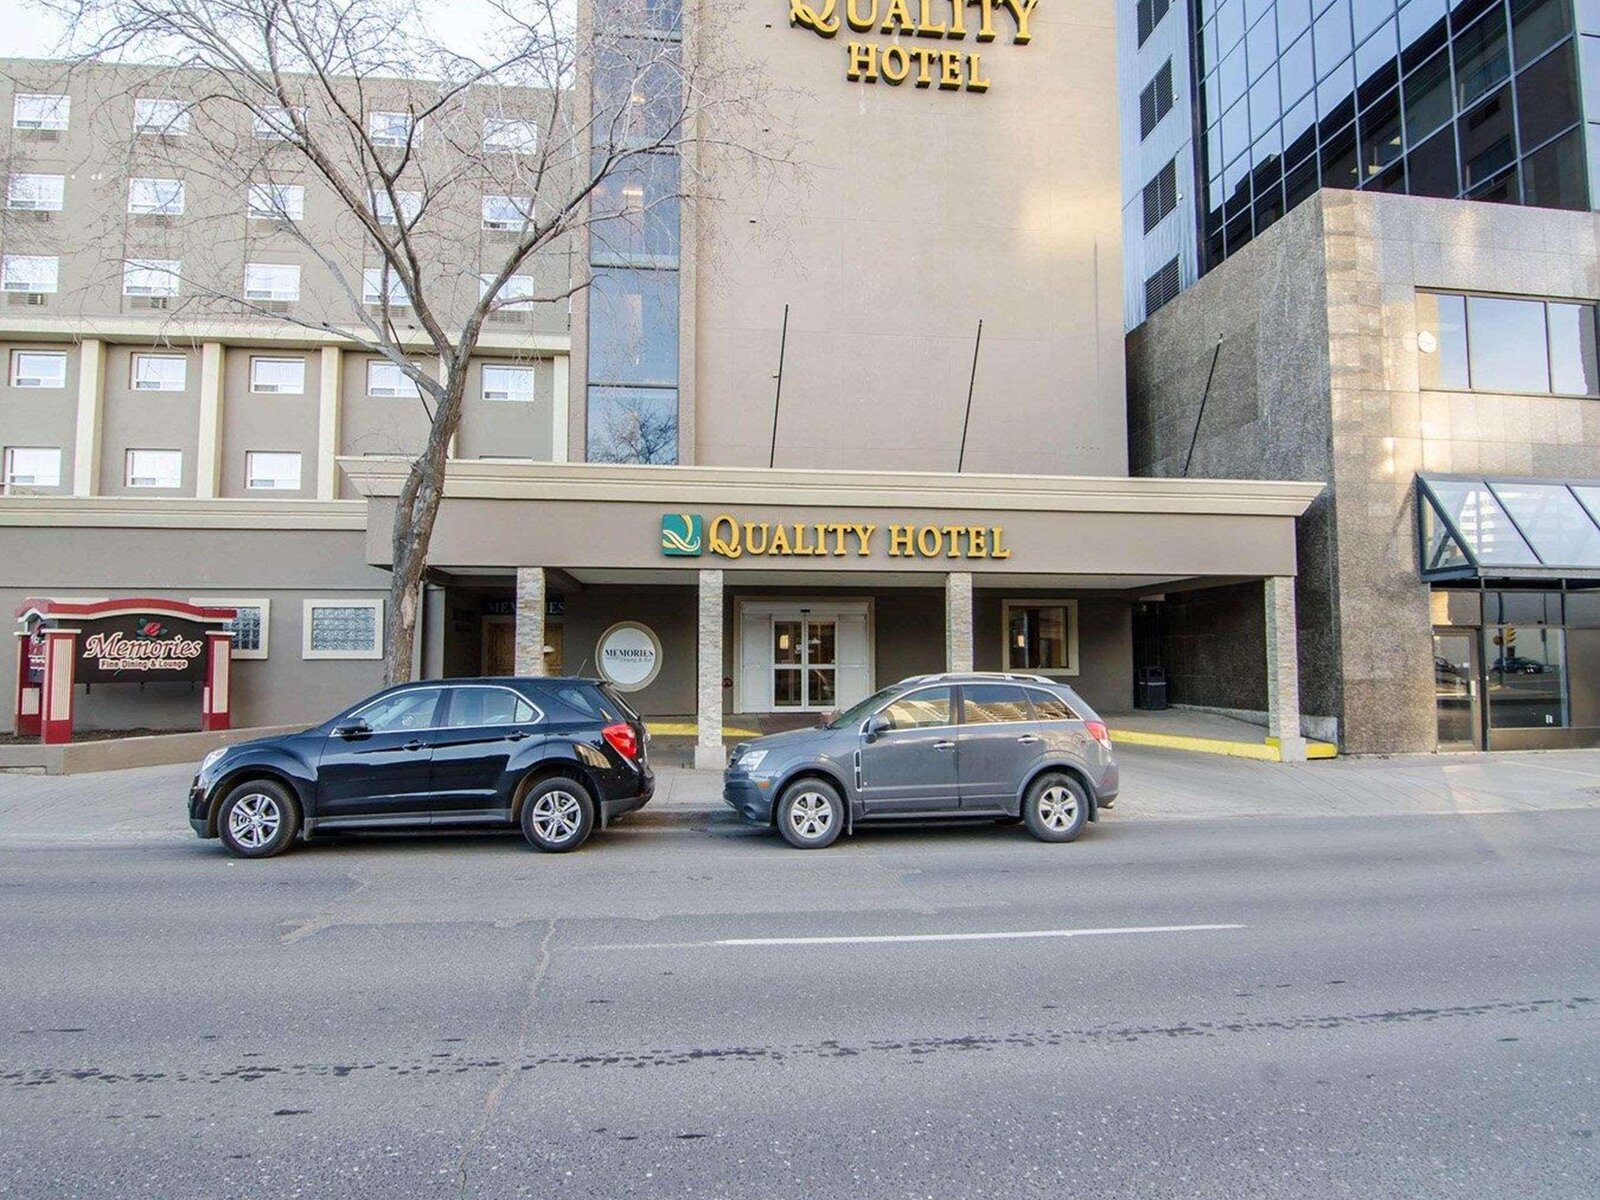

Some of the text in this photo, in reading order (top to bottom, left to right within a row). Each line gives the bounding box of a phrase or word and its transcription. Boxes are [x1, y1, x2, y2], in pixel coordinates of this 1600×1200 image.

[789, 0, 1038, 45] QUALITY
[847, 41, 991, 93] HOTEL
[708, 512, 1011, 559] QUALITY HOTEL
[83, 632, 203, 659] Memories
[605, 649, 654, 657] MEMORIES
[99, 660, 188, 671] Fine Dining & Lounge
